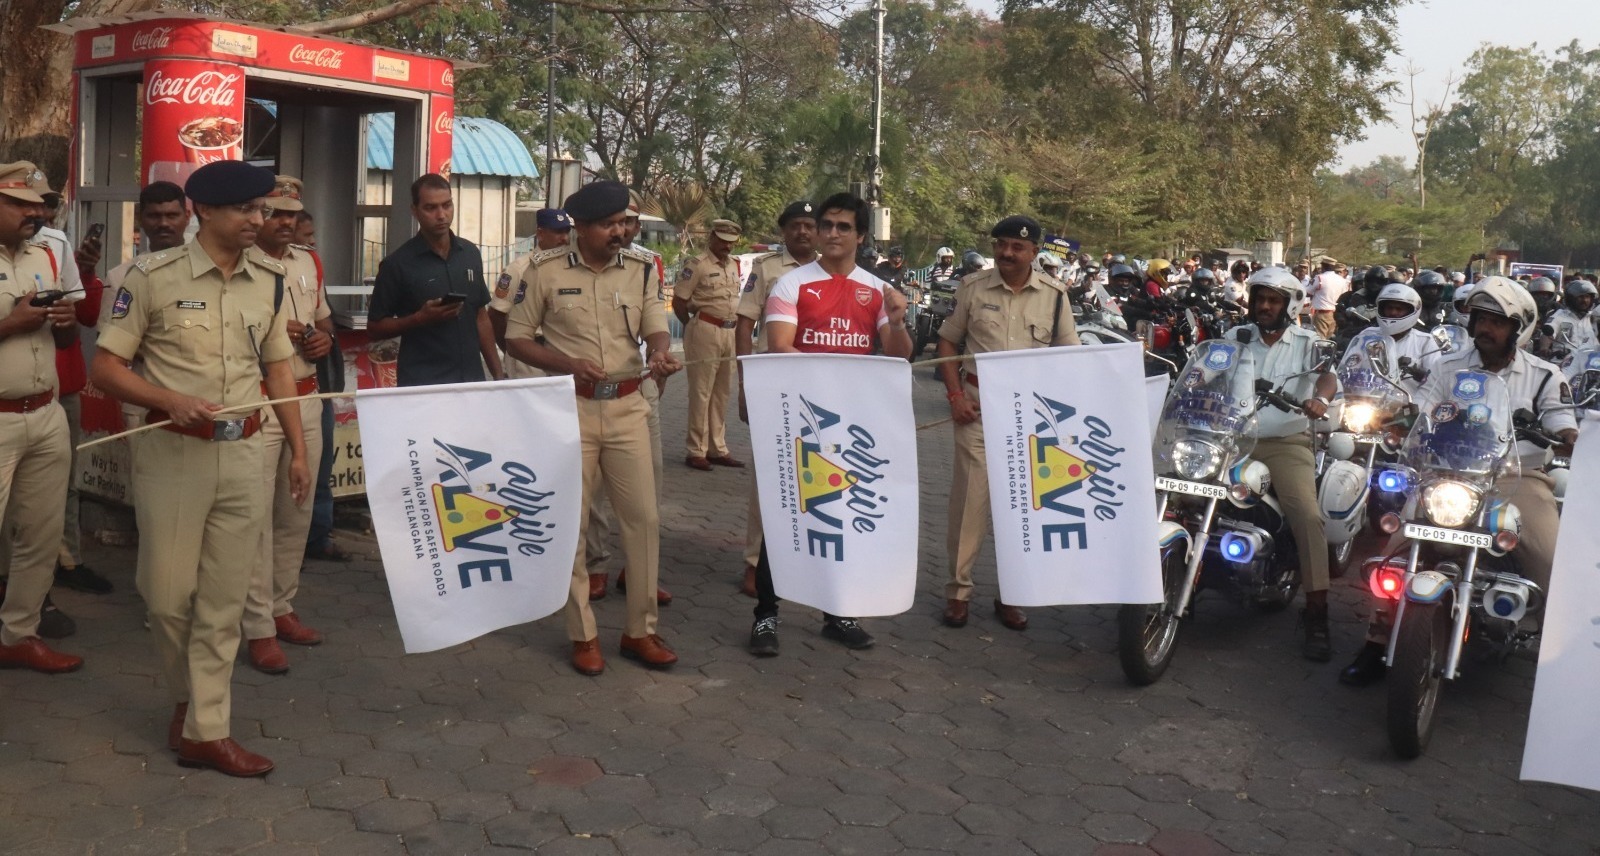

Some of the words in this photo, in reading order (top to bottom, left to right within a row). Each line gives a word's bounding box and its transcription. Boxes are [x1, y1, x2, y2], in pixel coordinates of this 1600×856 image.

[133, 26, 173, 52] Coca-Cola
[289, 43, 344, 70] Coca-Cola
[146, 70, 240, 107] Coca-Cola
[802, 328, 870, 348] Emirates
[830, 317, 851, 331] Fly
[776, 434, 783, 445] IN
[782, 402, 792, 460] CAMPAIGN
[1006, 435, 1013, 445] IN
[1014, 401, 1024, 457] CAMPAIGN
[83, 471, 95, 487] Car
[91, 452, 107, 473] Way
[110, 461, 118, 473] to
[329, 466, 366, 488] arki
[409, 450, 426, 508] CAMPAIGN
[777, 446, 788, 509] TELANGANA
[840, 424, 890, 534] arrive
[1006, 448, 1018, 510] TELANGANA
[1018, 459, 1026, 480] FOR
[1079, 415, 1126, 522] arrive
[401, 486, 410, 496] IN
[788, 482, 797, 515] SAFER
[1019, 482, 1028, 515] SAFER
[420, 509, 432, 527] FOR
[497, 461, 556, 557] arrive
[404, 497, 425, 560] TELANGANA
[424, 528, 439, 561] SAFER
[792, 517, 800, 552] ROADS
[1022, 517, 1031, 553] ROADS
[432, 561, 447, 597] ROADS
